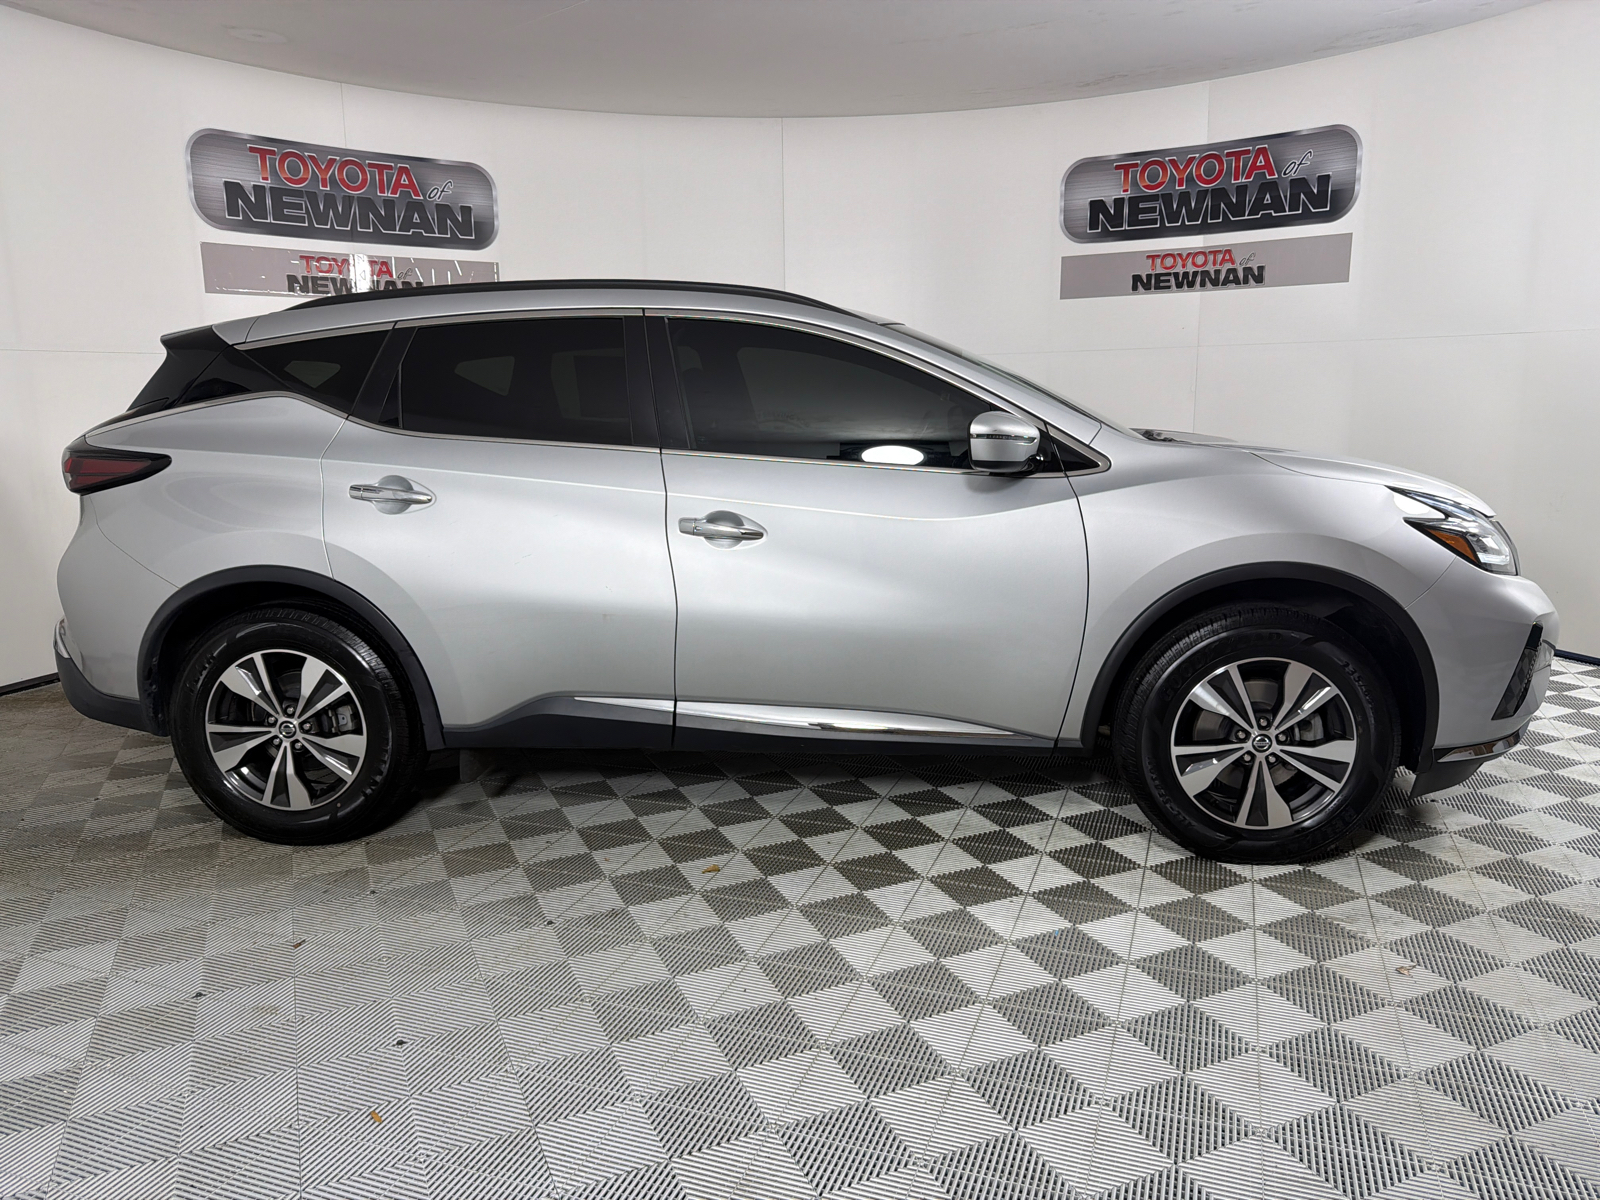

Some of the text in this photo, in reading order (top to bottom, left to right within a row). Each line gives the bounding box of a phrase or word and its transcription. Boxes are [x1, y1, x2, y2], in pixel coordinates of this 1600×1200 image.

[247, 144, 454, 201] TOYOTA of
[1114, 145, 1314, 194] TOYOTA of
[222, 179, 475, 239] NEWNAN
[1087, 172, 1332, 233] NEWNAN
[299, 254, 413, 280] TOYTA of
[1131, 265, 1265, 292] NEWNAN
[1146, 248, 1257, 271] TOYOTA of
